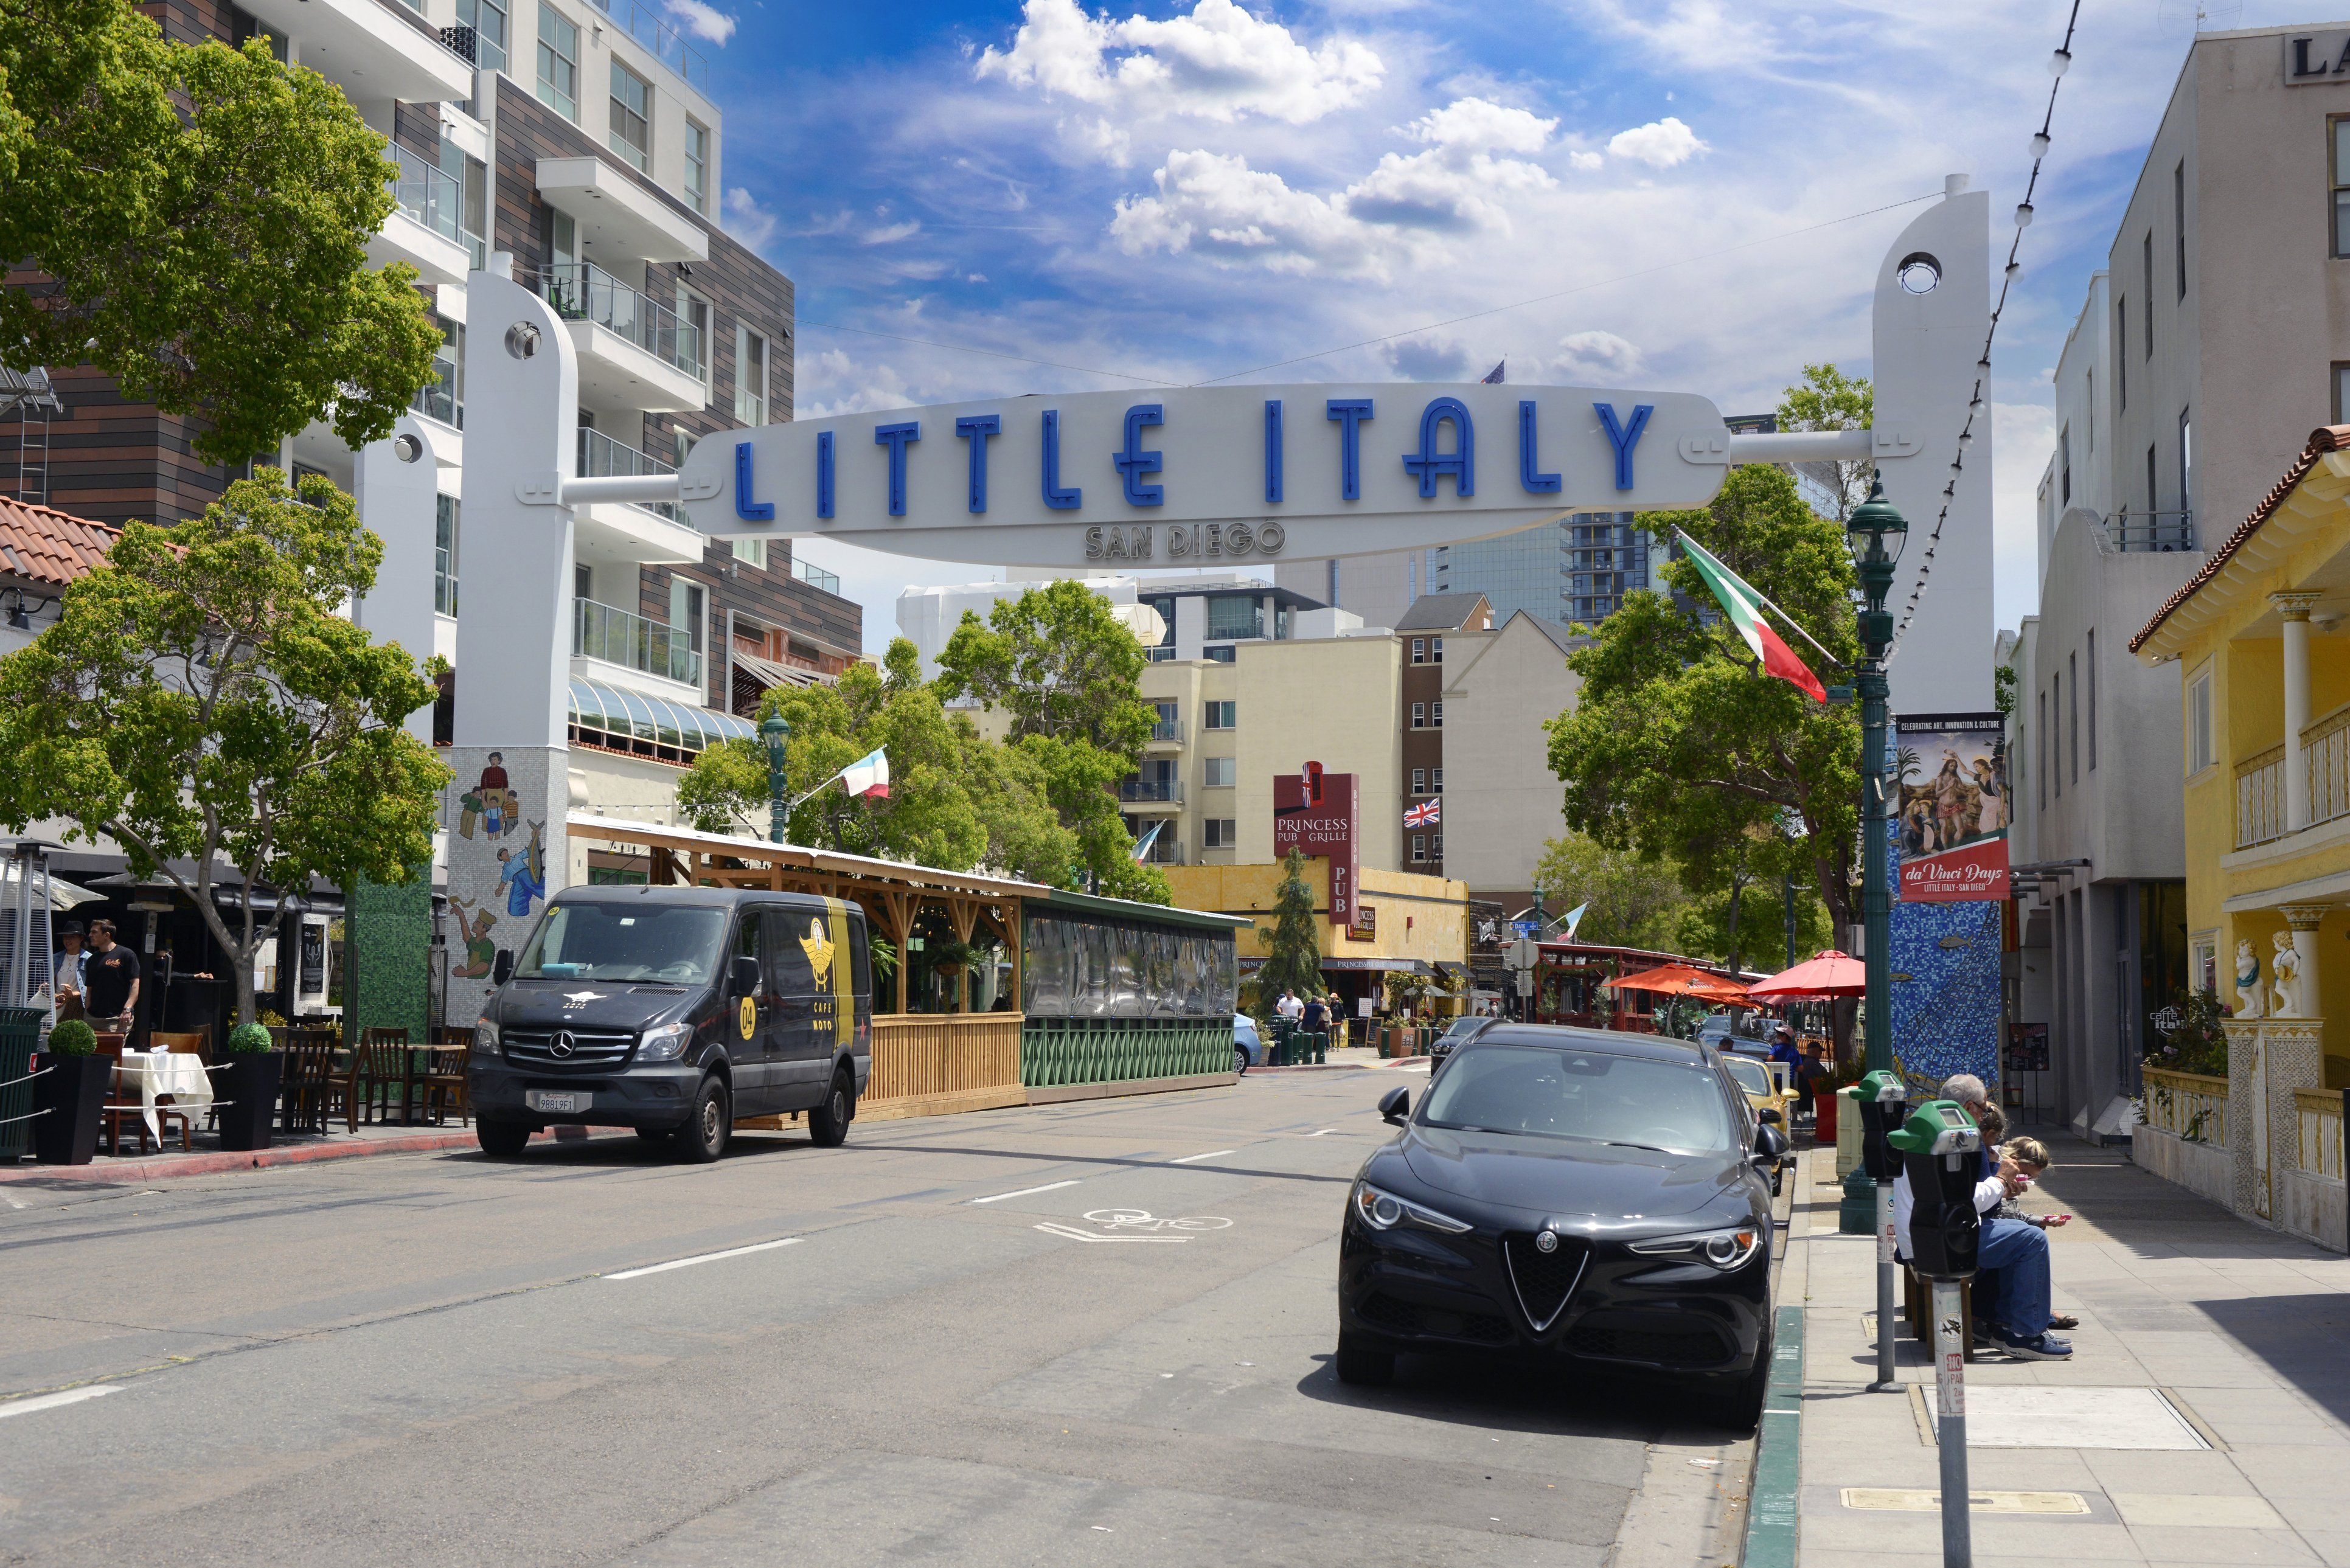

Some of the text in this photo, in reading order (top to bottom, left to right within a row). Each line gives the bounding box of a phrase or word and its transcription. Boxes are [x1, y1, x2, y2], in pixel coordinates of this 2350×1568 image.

[735, 396, 1655, 521] LITTLE ITALY
[1085, 521, 1287, 558] SAN DIEGO
[1901, 722, 1932, 730] CELEBRATING
[1945, 721, 1973, 729] INNOVATION
[1980, 720, 2000, 729] CULTURE
[1278, 819, 1347, 833] PRINCESS
[1278, 832, 1347, 842] PUB GRILLE
[1905, 863, 2004, 886] da Vinci Days
[1334, 867, 1347, 912] PUB
[1924, 884, 1941, 892] LITTLE
[813, 1002, 832, 1013] CAFE
[742, 1006, 753, 1030] 04
[813, 1019, 832, 1031] MOTO
[541, 1099, 572, 1110] 98819F1
[1948, 1356, 1962, 1370] NO
